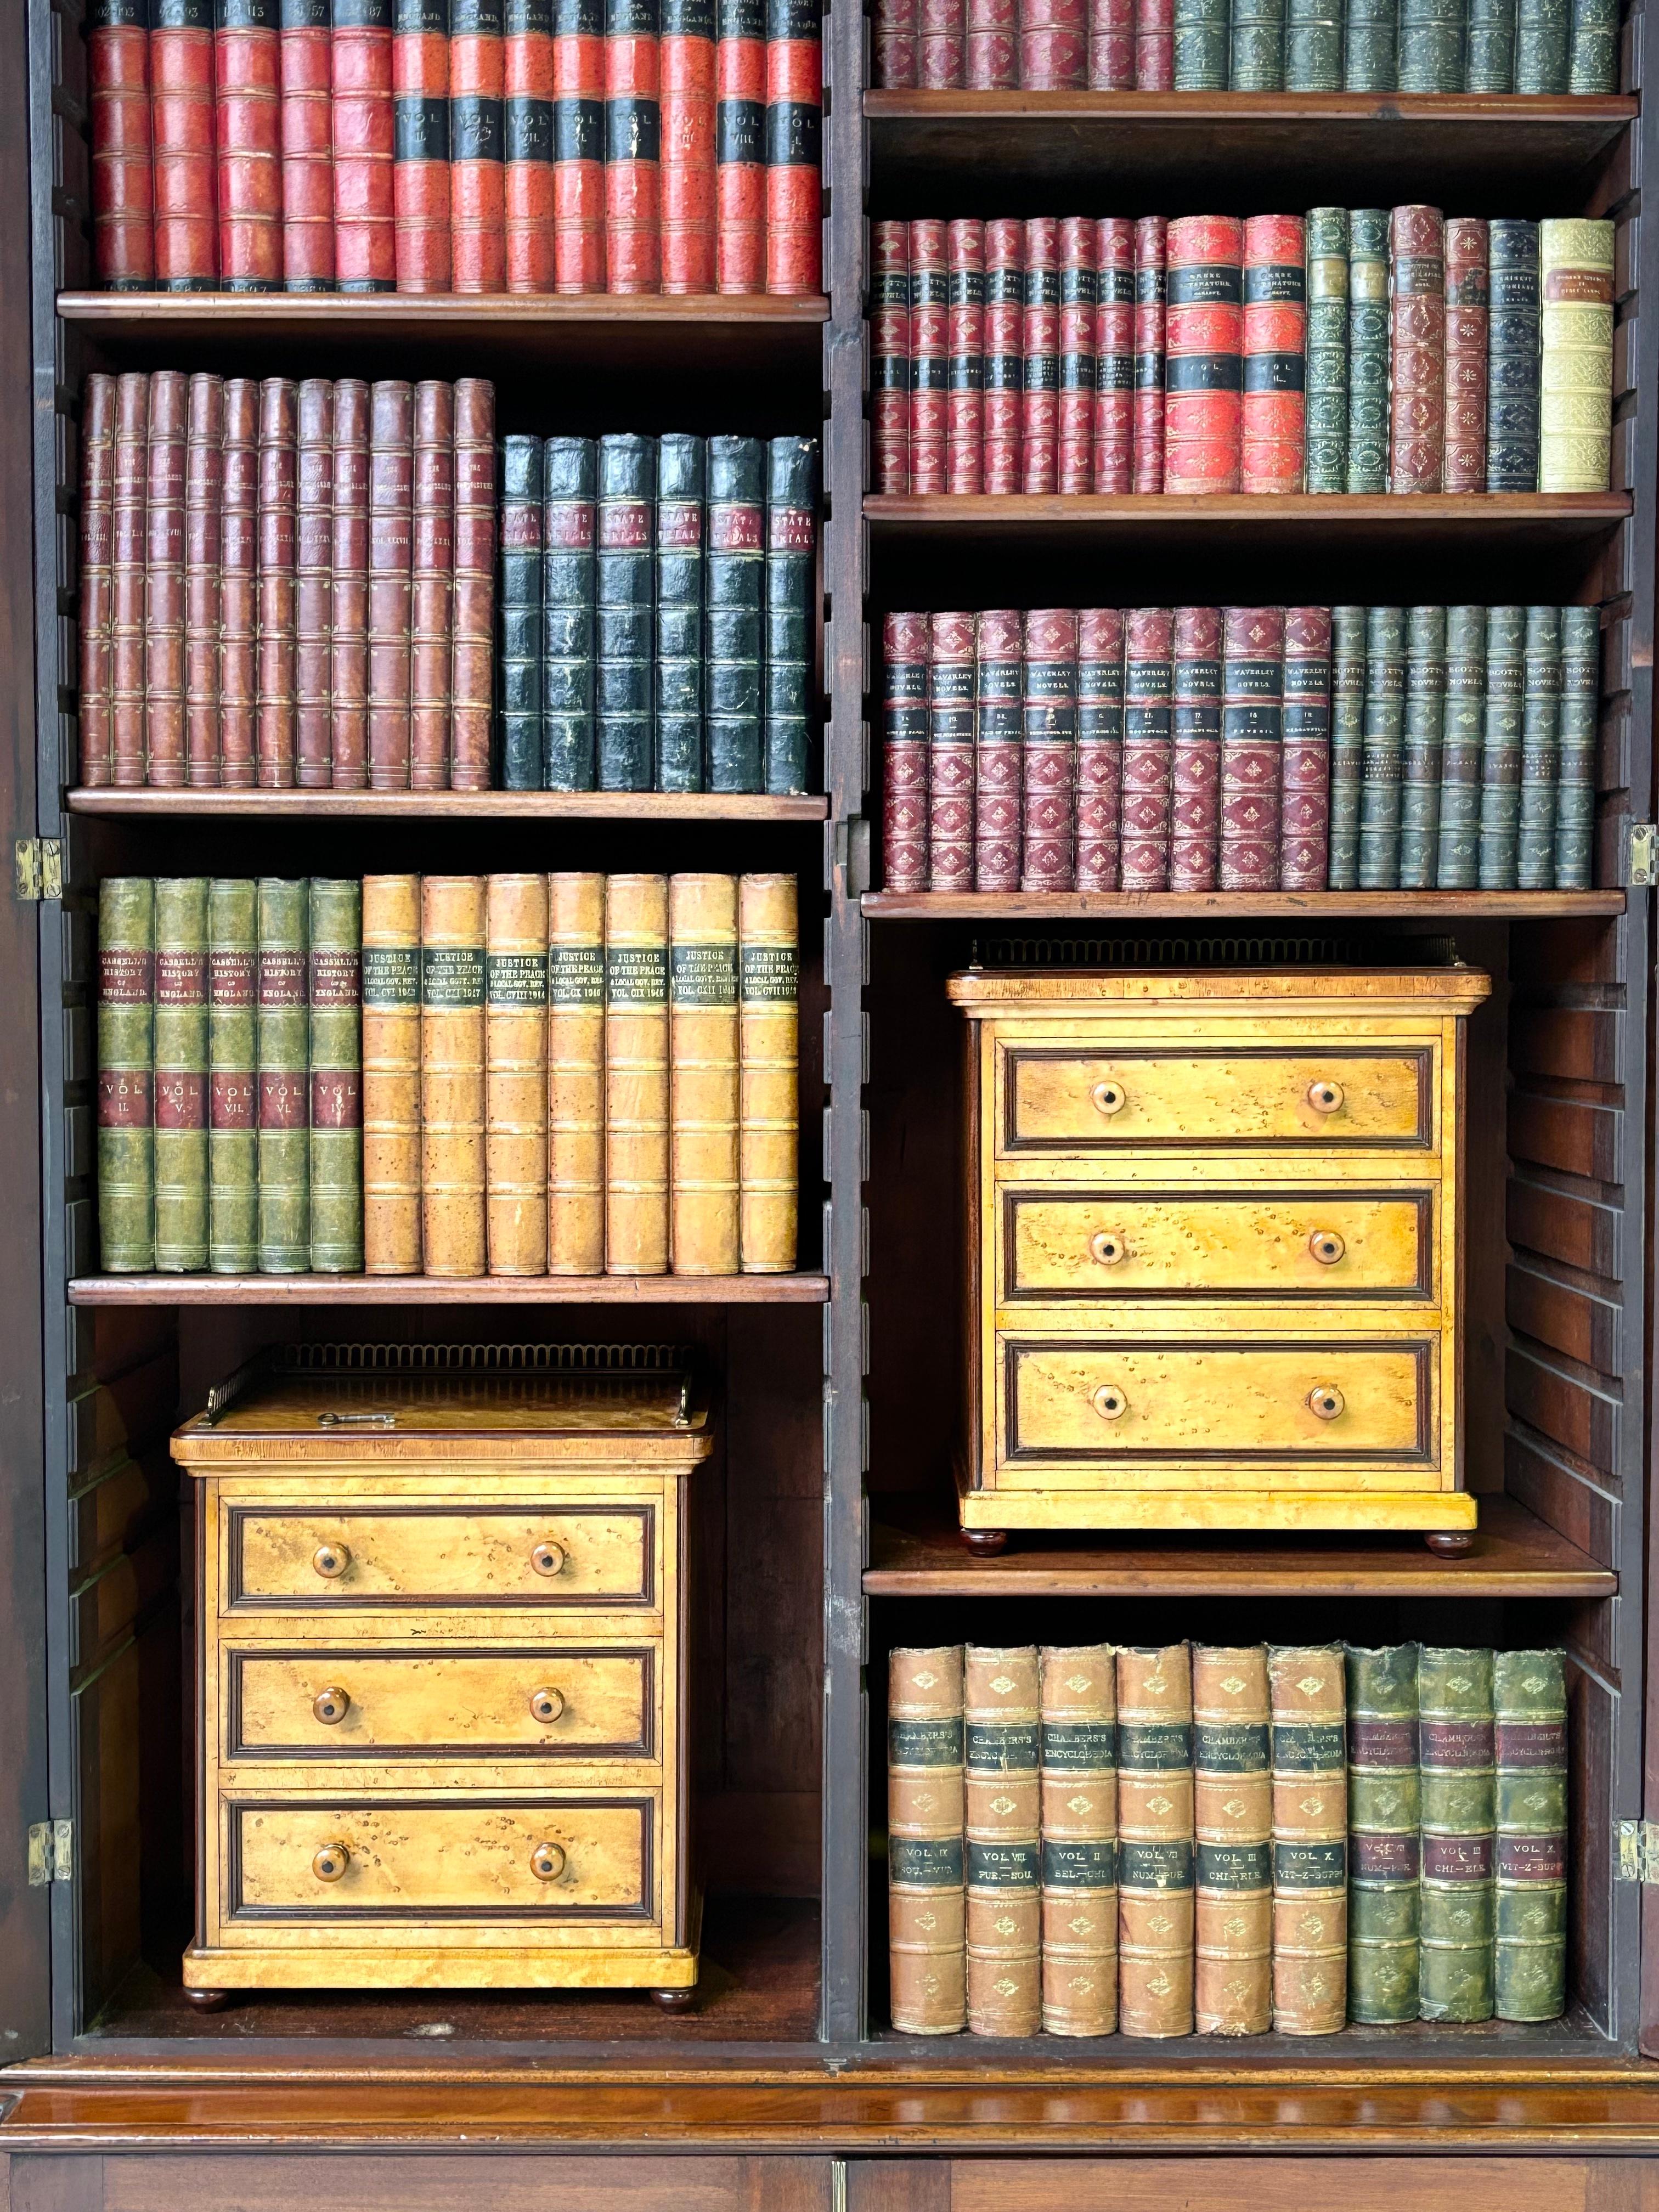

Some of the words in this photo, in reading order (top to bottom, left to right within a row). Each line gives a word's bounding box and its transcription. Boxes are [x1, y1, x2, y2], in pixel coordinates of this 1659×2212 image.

[501, 513, 537, 523] STATE
[607, 514, 644, 524] STATE
[660, 512, 697, 522] STATE
[775, 516, 811, 527] STATE
[771, 534, 815, 544] TRIALS
[369, 953, 411, 964] JUSTICE
[558, 952, 596, 962] JUSTICE
[617, 953, 660, 963] JUSTICE
[685, 951, 724, 961] JUSTICE
[751, 952, 793, 962] JUSTICE
[495, 958, 539, 968] JUSTICE
[104, 968, 143, 977] HISTORY
[317, 969, 354, 977] HISTORY
[364, 966, 373, 975] OF
[374, 966, 390, 975] THE
[489, 969, 499, 979] OF
[501, 969, 518, 979] THE
[551, 965, 560, 974] OF
[562, 965, 578, 974] THE
[610, 966, 620, 975] OF
[620, 966, 639, 975] THE
[639, 966, 665, 975] PEACE
[744, 964, 755, 974] OF
[756, 964, 774, 974] THE
[106, 1084, 143, 1095] VOL
[162, 1085, 199, 1096] VOL
[215, 1087, 251, 1097] VOL
[266, 1086, 302, 1096] VOL
[320, 1085, 356, 1096] VOL
[1047, 1734, 1107, 1743] CHAMBERS'S
[1093, 1852, 1101, 1860] II
[1248, 1853, 1256, 1862] III
[1324, 1852, 1334, 1860] X
